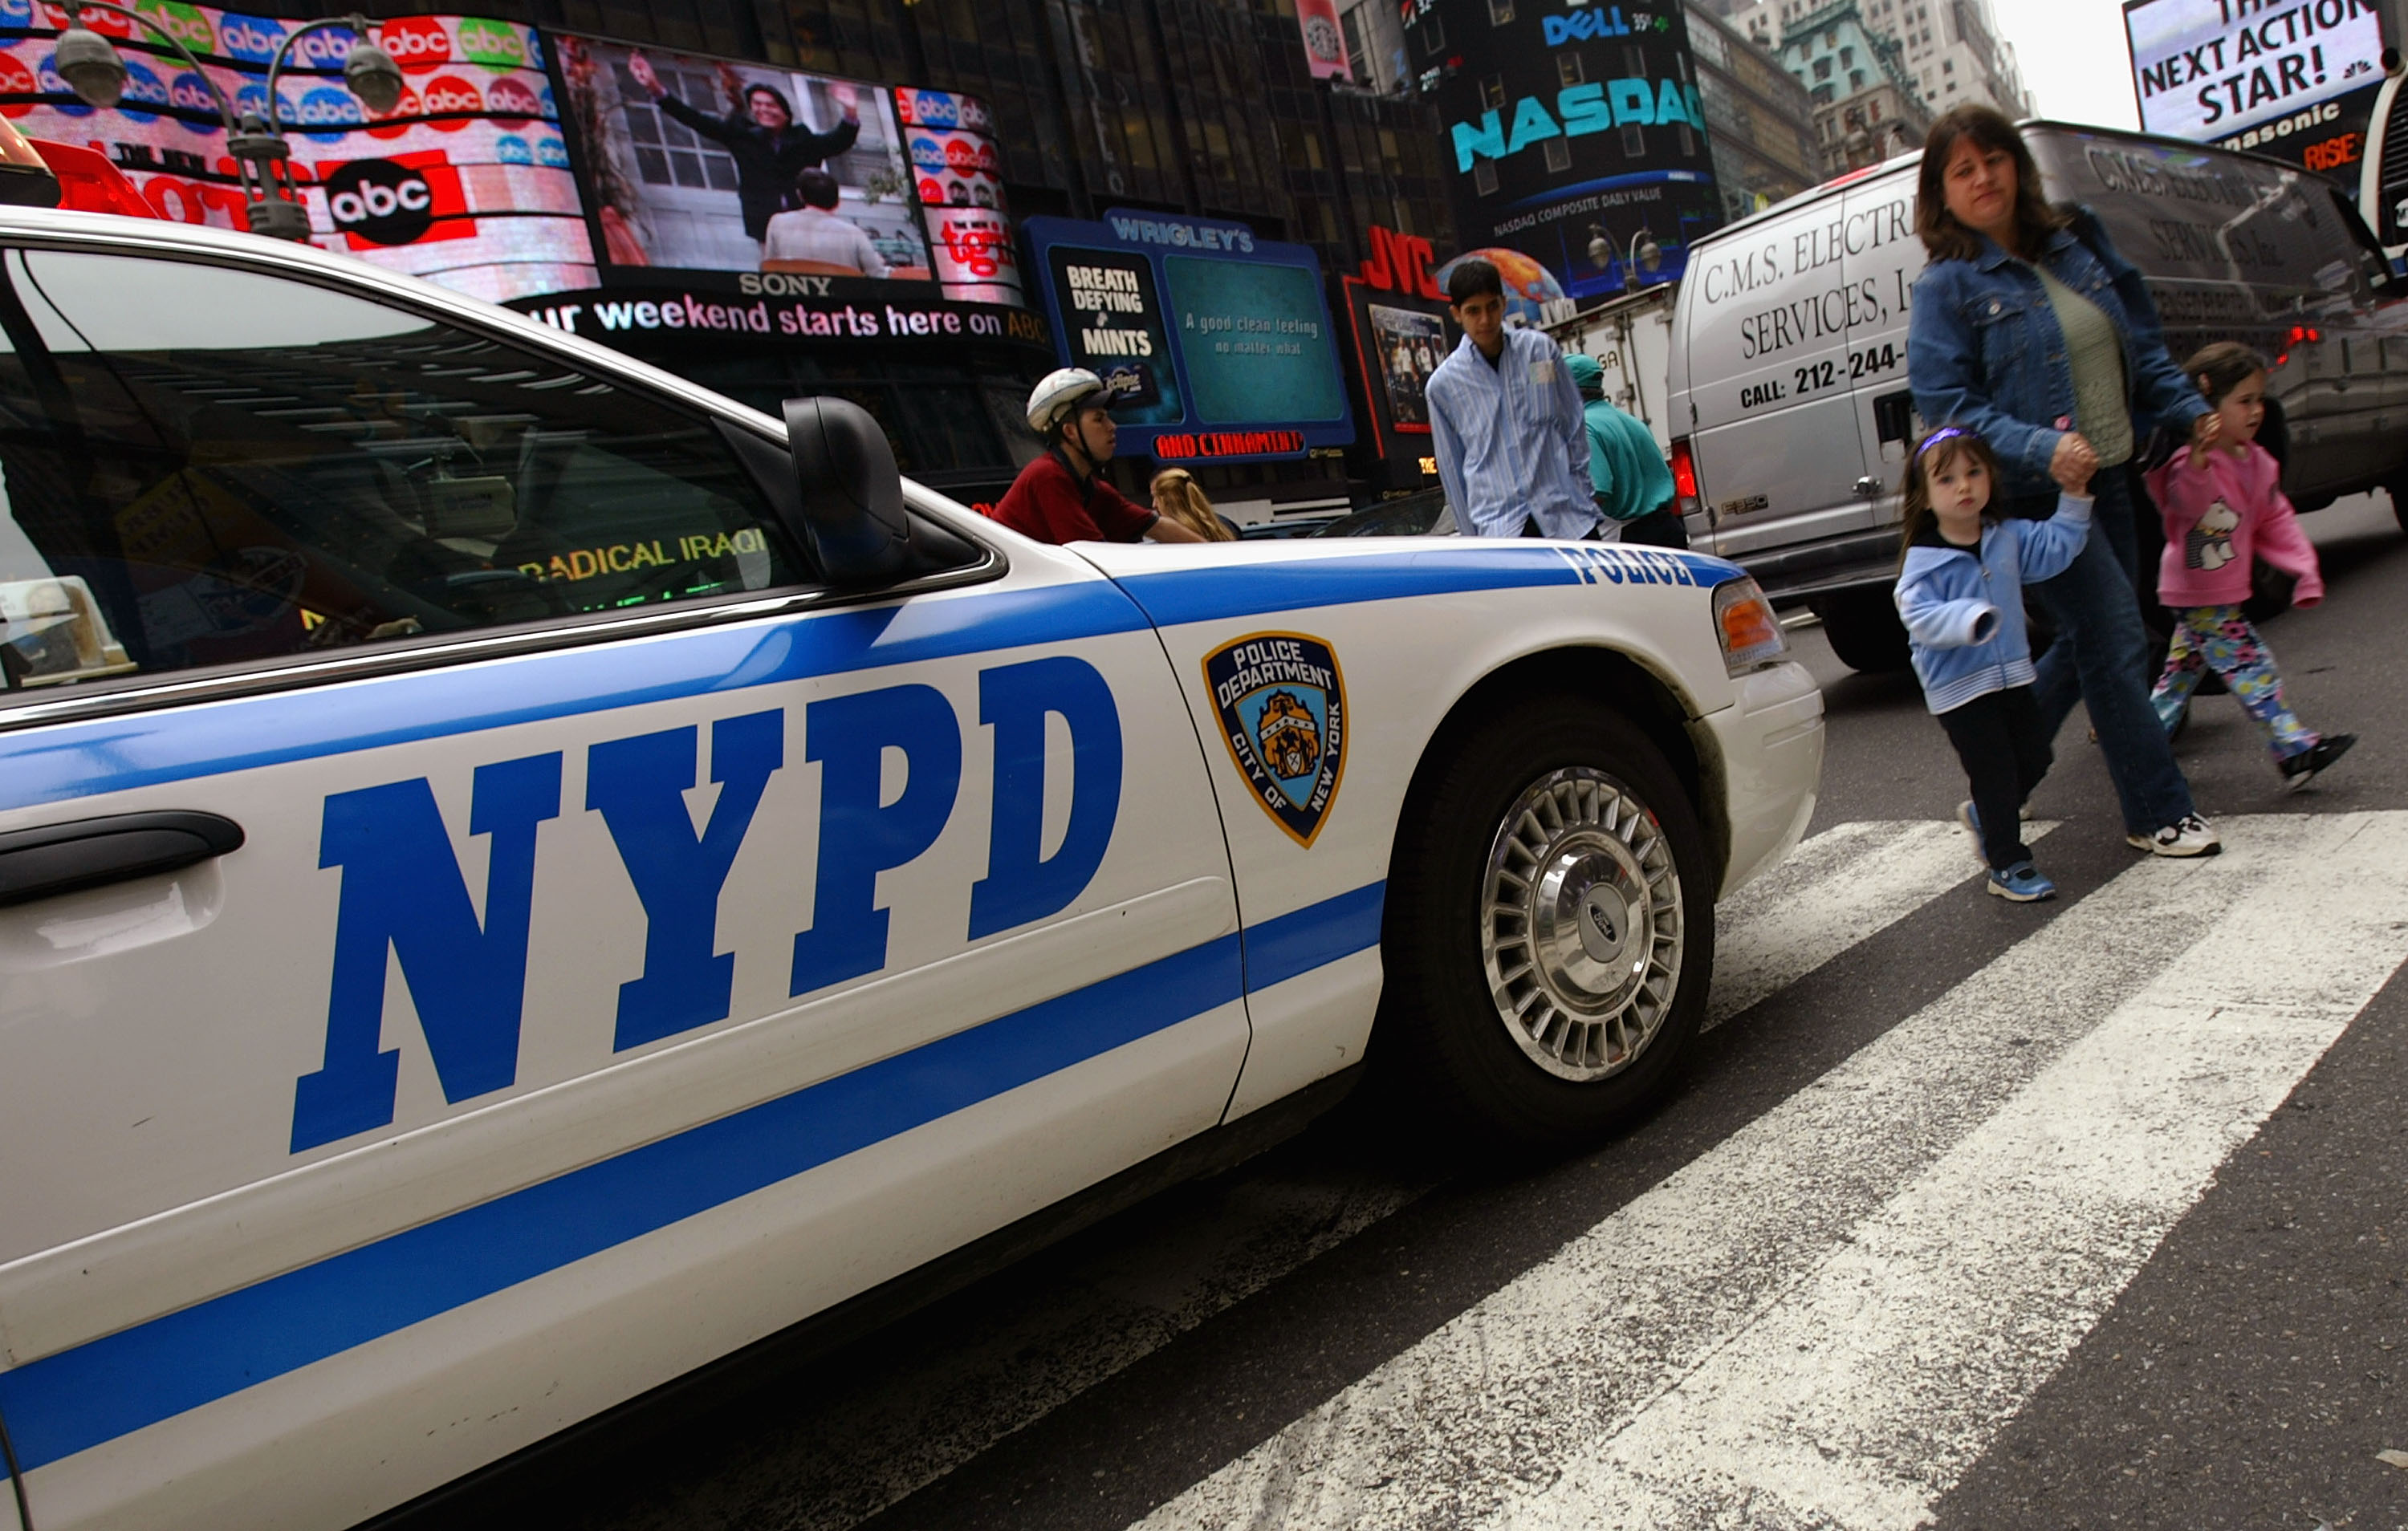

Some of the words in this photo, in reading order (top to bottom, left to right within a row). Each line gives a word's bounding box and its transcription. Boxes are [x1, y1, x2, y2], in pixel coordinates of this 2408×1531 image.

[383, 27, 449, 57] abc
[462, 26, 523, 56] abc
[1542, 6, 1629, 47] DELL
[2142, 37, 2226, 98] NEXT
[2198, 43, 2328, 124] STAR!
[2216, 102, 2341, 152] nasonic
[331, 177, 430, 223] abc
[1494, 214, 1536, 238] NASDAQ
[1537, 197, 1600, 224] COMPOSITE
[1602, 190, 1631, 209] DAILY
[1631, 186, 1662, 202] VALUE
[1111, 217, 1254, 253] WRIGLEY'S
[1066, 265, 1139, 292] BREATH
[1360, 225, 1440, 300] JVC
[1705, 244, 1784, 304] C.M.S.
[738, 273, 832, 296] SONY
[1072, 289, 1144, 313] DEFYING
[593, 293, 771, 333] weekend
[779, 303, 880, 336] starts
[885, 303, 962, 336] here
[969, 312, 1003, 336] on
[1186, 312, 1195, 329] A
[1201, 315, 1231, 334] good
[1237, 316, 1271, 331] clean
[1276, 318, 1318, 339] feeling
[1741, 277, 1887, 359] SERVICES,
[1082, 327, 1152, 356] MINTS
[1215, 341, 1230, 353] no
[1741, 380, 1786, 408] CALL:
[679, 527, 765, 561] IRAQI
[1553, 547, 1698, 587] POLICE
[1233, 640, 1304, 671] POLICE
[1218, 661, 1332, 709] DEPARTMENT
[1231, 732, 1265, 782] CITY
[1263, 785, 1287, 810] OF
[1310, 766, 1335, 812] NEW
[1326, 702, 1340, 757] YORK
[289, 656, 1123, 1155] NYPD
